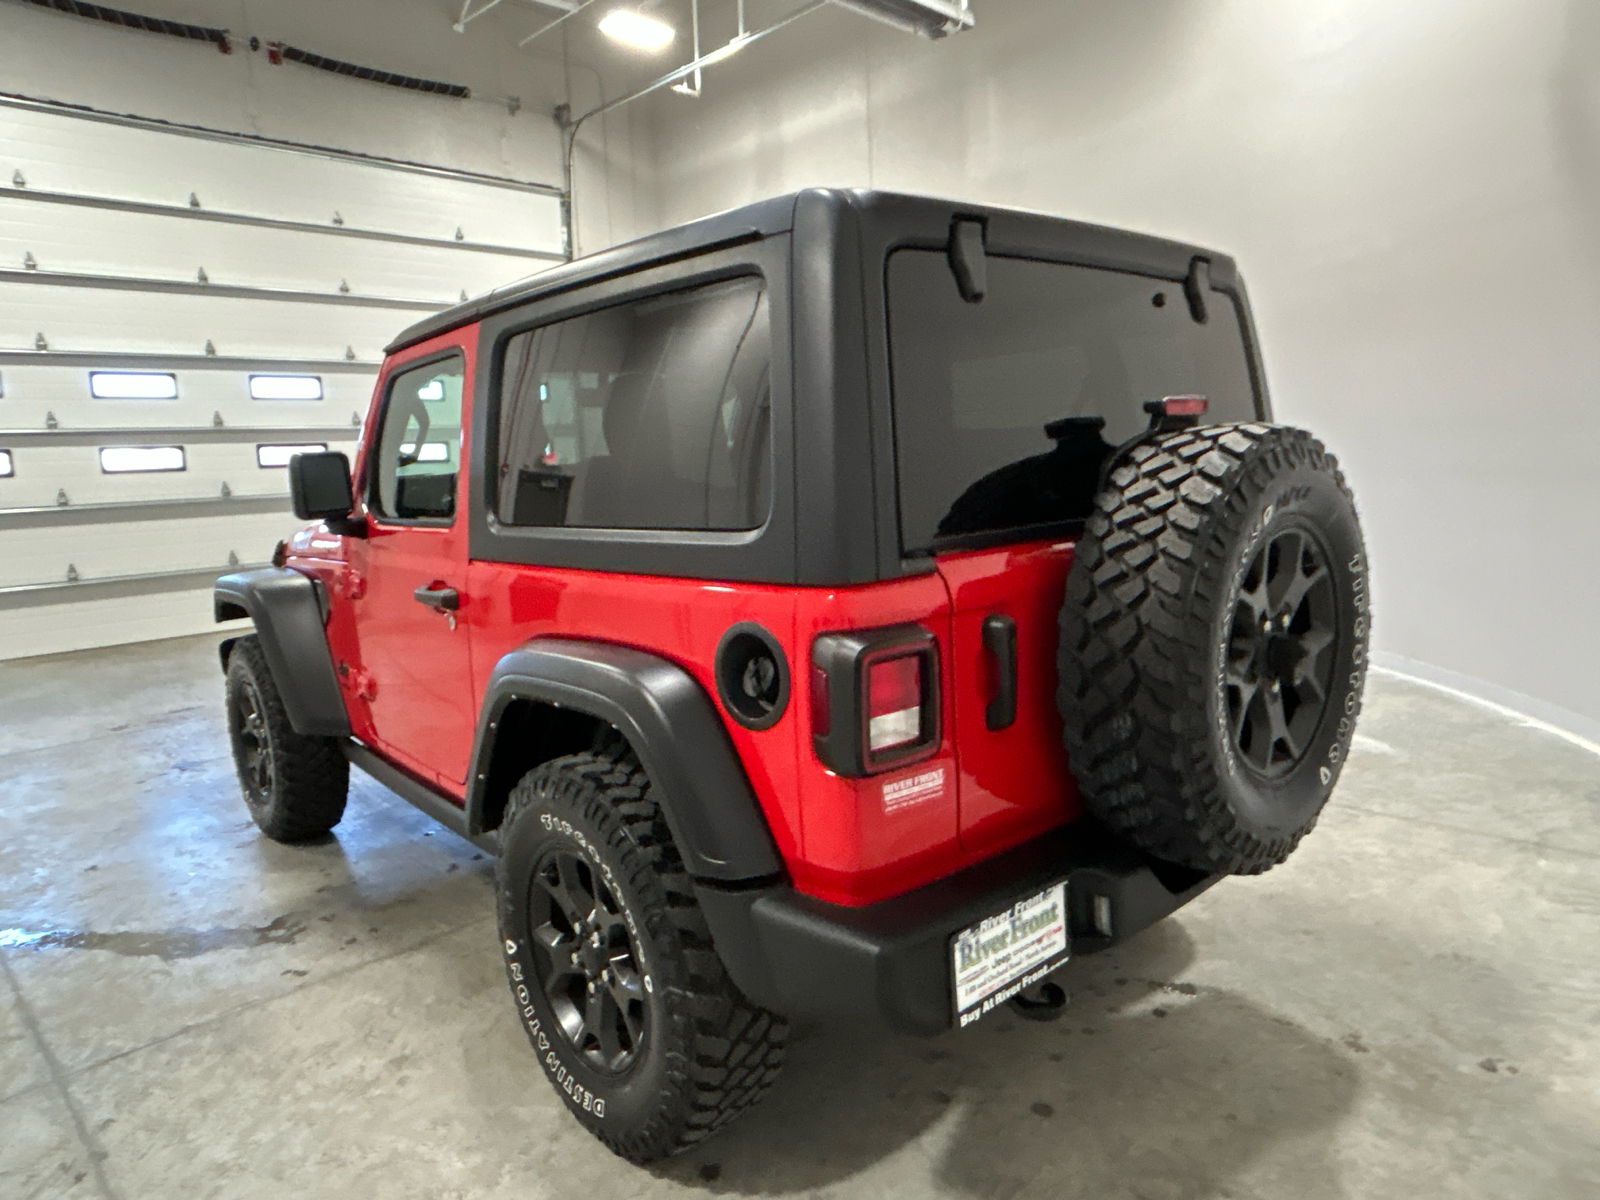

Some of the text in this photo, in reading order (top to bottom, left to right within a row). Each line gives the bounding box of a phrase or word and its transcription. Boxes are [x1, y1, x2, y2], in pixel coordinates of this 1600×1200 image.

[511, 962, 606, 1118] DESTINATION
[960, 1009, 981, 1028] Buy
[982, 998, 995, 1014] At
[995, 982, 1021, 1006] River
